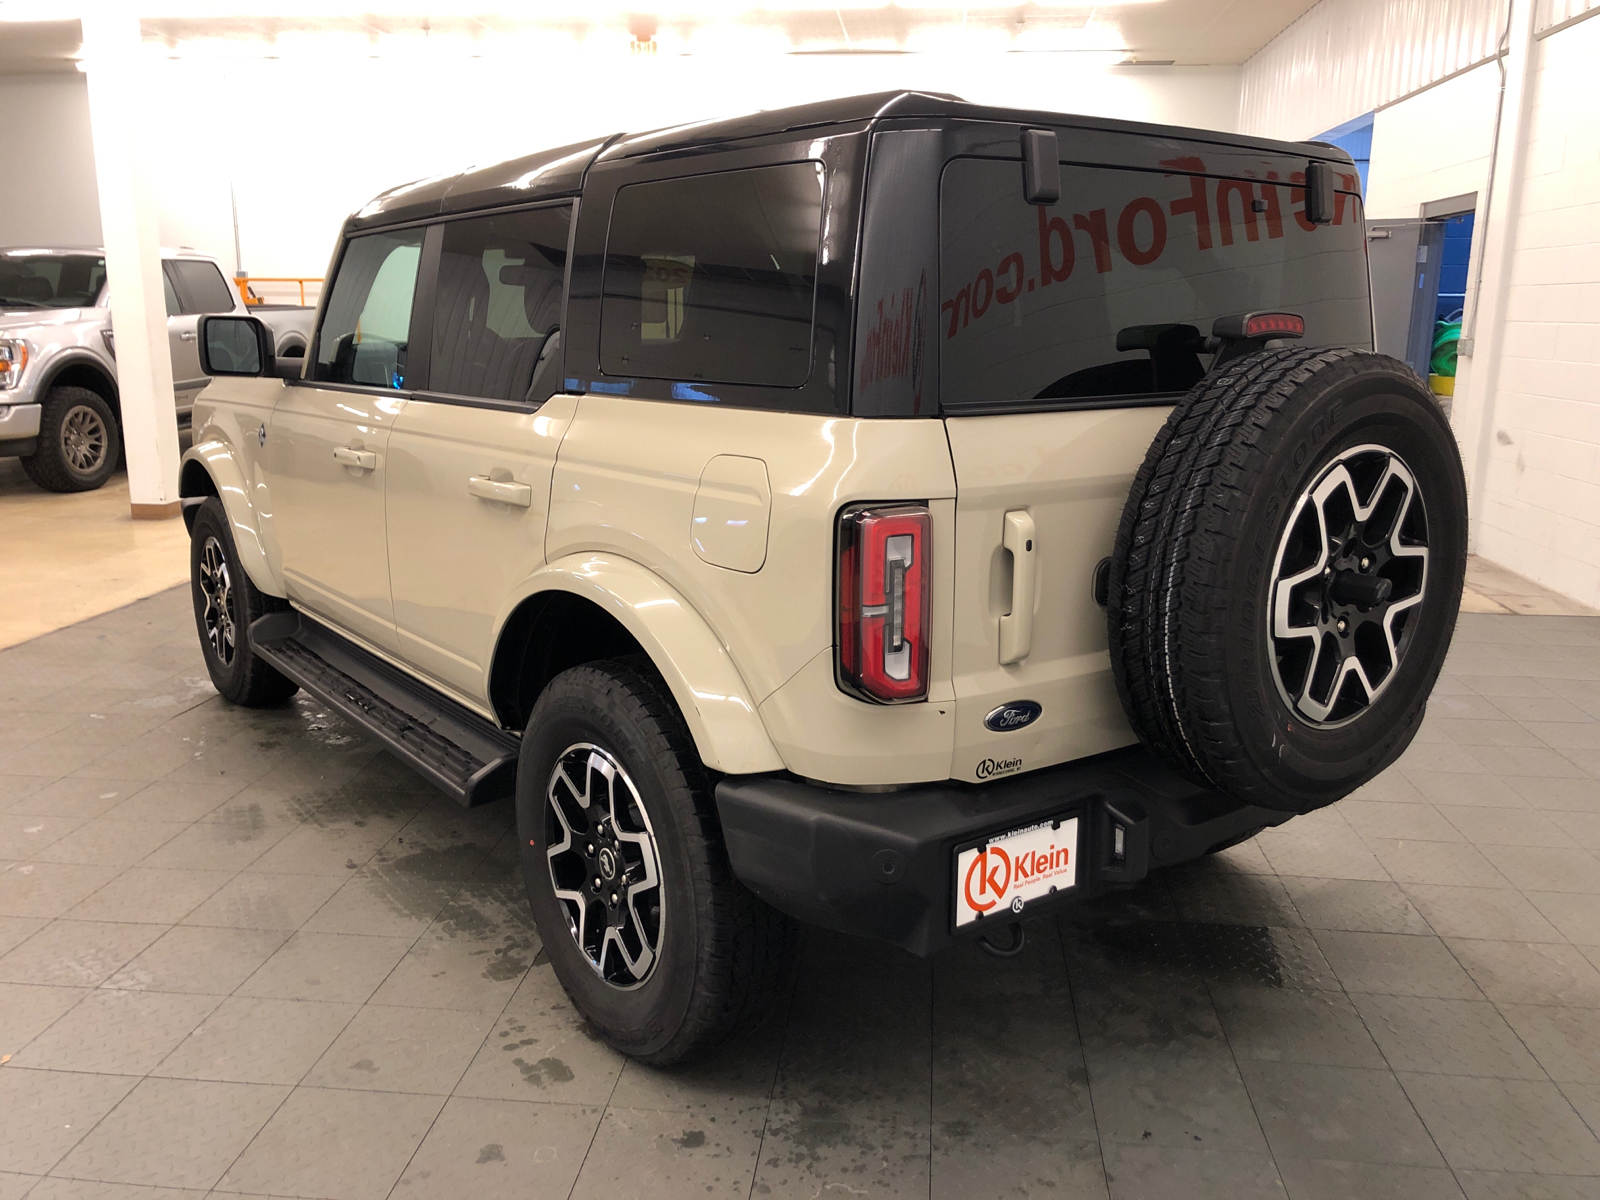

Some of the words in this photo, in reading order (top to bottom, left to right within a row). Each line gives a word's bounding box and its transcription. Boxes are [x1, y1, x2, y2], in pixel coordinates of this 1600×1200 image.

[999, 708, 1032, 728] Ford
[996, 757, 1022, 771] Klein
[988, 820, 1053, 843] www.kleinauto.com
[1014, 844, 1069, 882] Klein
[1013, 881, 1024, 890] Real
[1042, 872, 1053, 880] Real
